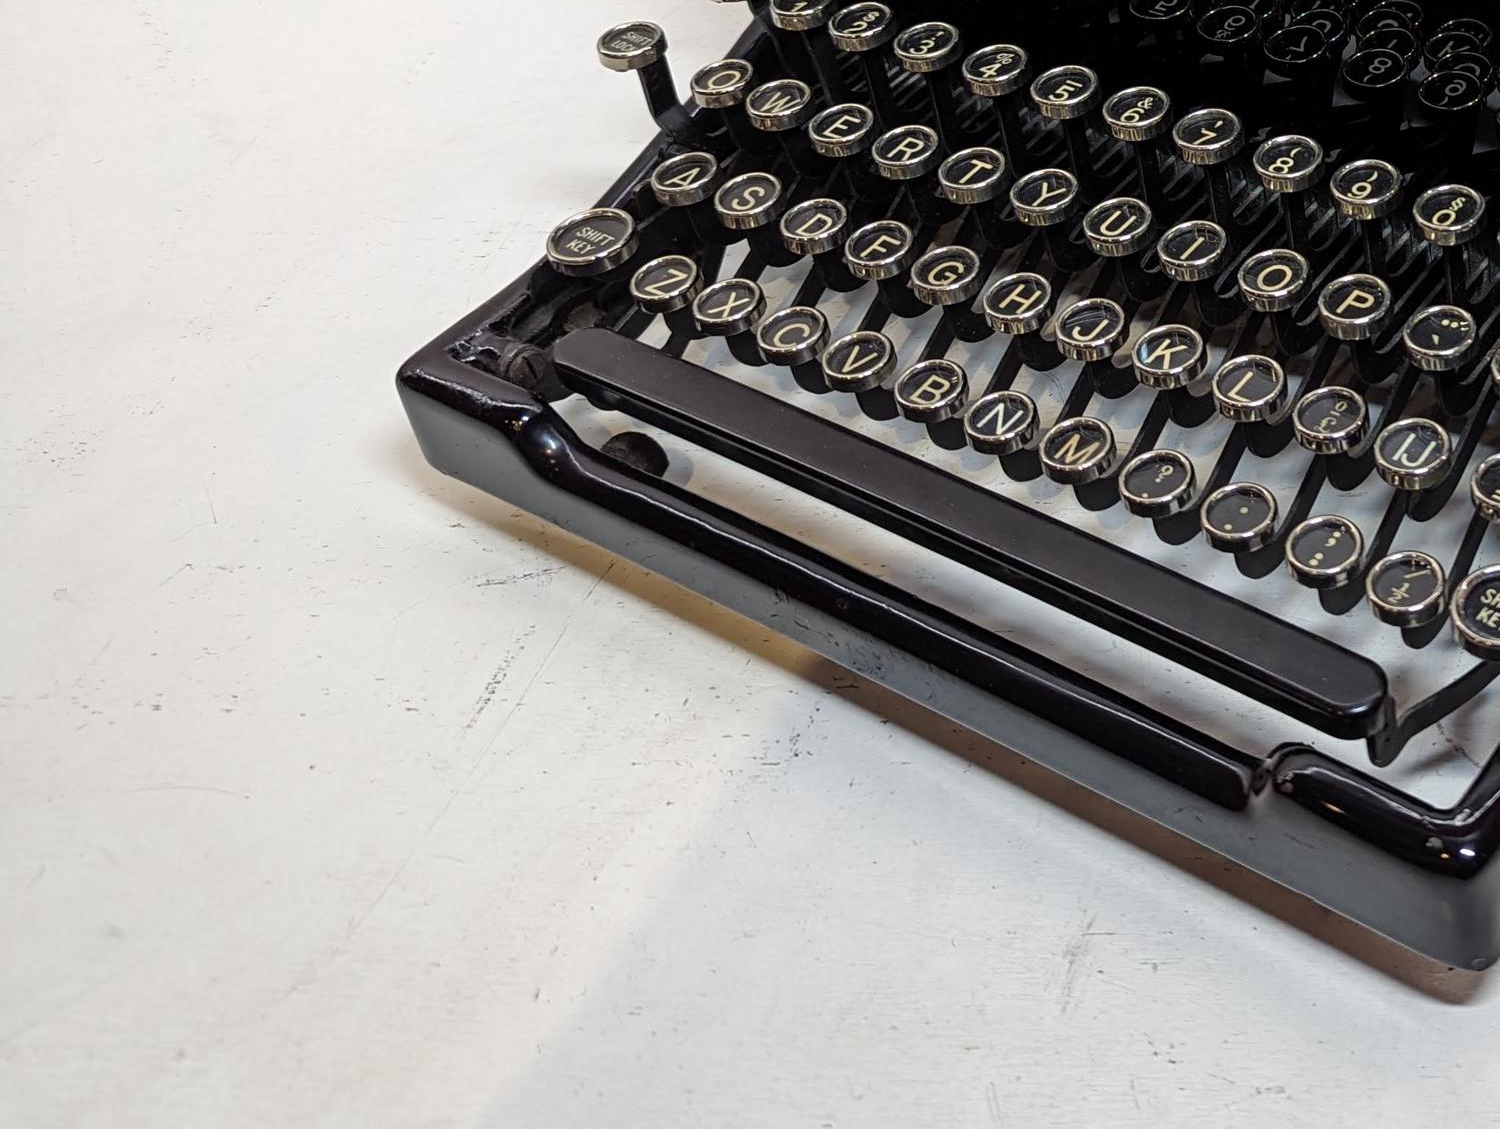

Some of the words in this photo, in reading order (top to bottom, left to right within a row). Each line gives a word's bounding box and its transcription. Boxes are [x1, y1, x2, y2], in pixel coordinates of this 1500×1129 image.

[790, 1, 808, 13] 1
[843, 20, 868, 33] 2
[610, 40, 637, 52] LOCK
[623, 31, 653, 46] SHIFT
[910, 39, 936, 55] 3
[996, 53, 1016, 64] %
[706, 69, 741, 92] Q
[979, 64, 1002, 78] 4
[761, 92, 800, 114] W
[1048, 86, 1073, 102] 5
[1137, 97, 1154, 110] &
[1119, 107, 1145, 122] 6
[827, 115, 860, 139] E
[1192, 127, 1217, 146] 7
[891, 137, 926, 162] R
[668, 165, 701, 187] A
[958, 159, 993, 184] T
[1268, 156, 1294, 174] 8
[731, 186, 766, 209] S
[1031, 182, 1068, 207] Y
[1347, 181, 1372, 199] 9
[796, 213, 834, 237] D
[1100, 210, 1138, 237] U
[566, 238, 597, 255] KEY
[576, 226, 616, 247] SHIFT
[860, 234, 902, 259] F
[645, 269, 690, 296] Z
[927, 260, 965, 287] G
[1256, 264, 1293, 291] O
[707, 291, 751, 318] X
[998, 283, 1043, 315] H
[1336, 289, 1374, 314] P
[772, 322, 812, 348] C
[1071, 319, 1110, 343] J
[841, 345, 879, 373] V
[1145, 338, 1188, 370] K
[908, 374, 950, 405] B
[1227, 371, 1255, 403] L
[976, 402, 1024, 435] N
[1053, 433, 1100, 465] M
[1154, 464, 1174, 484] ?
[1325, 530, 1342, 548] ;
